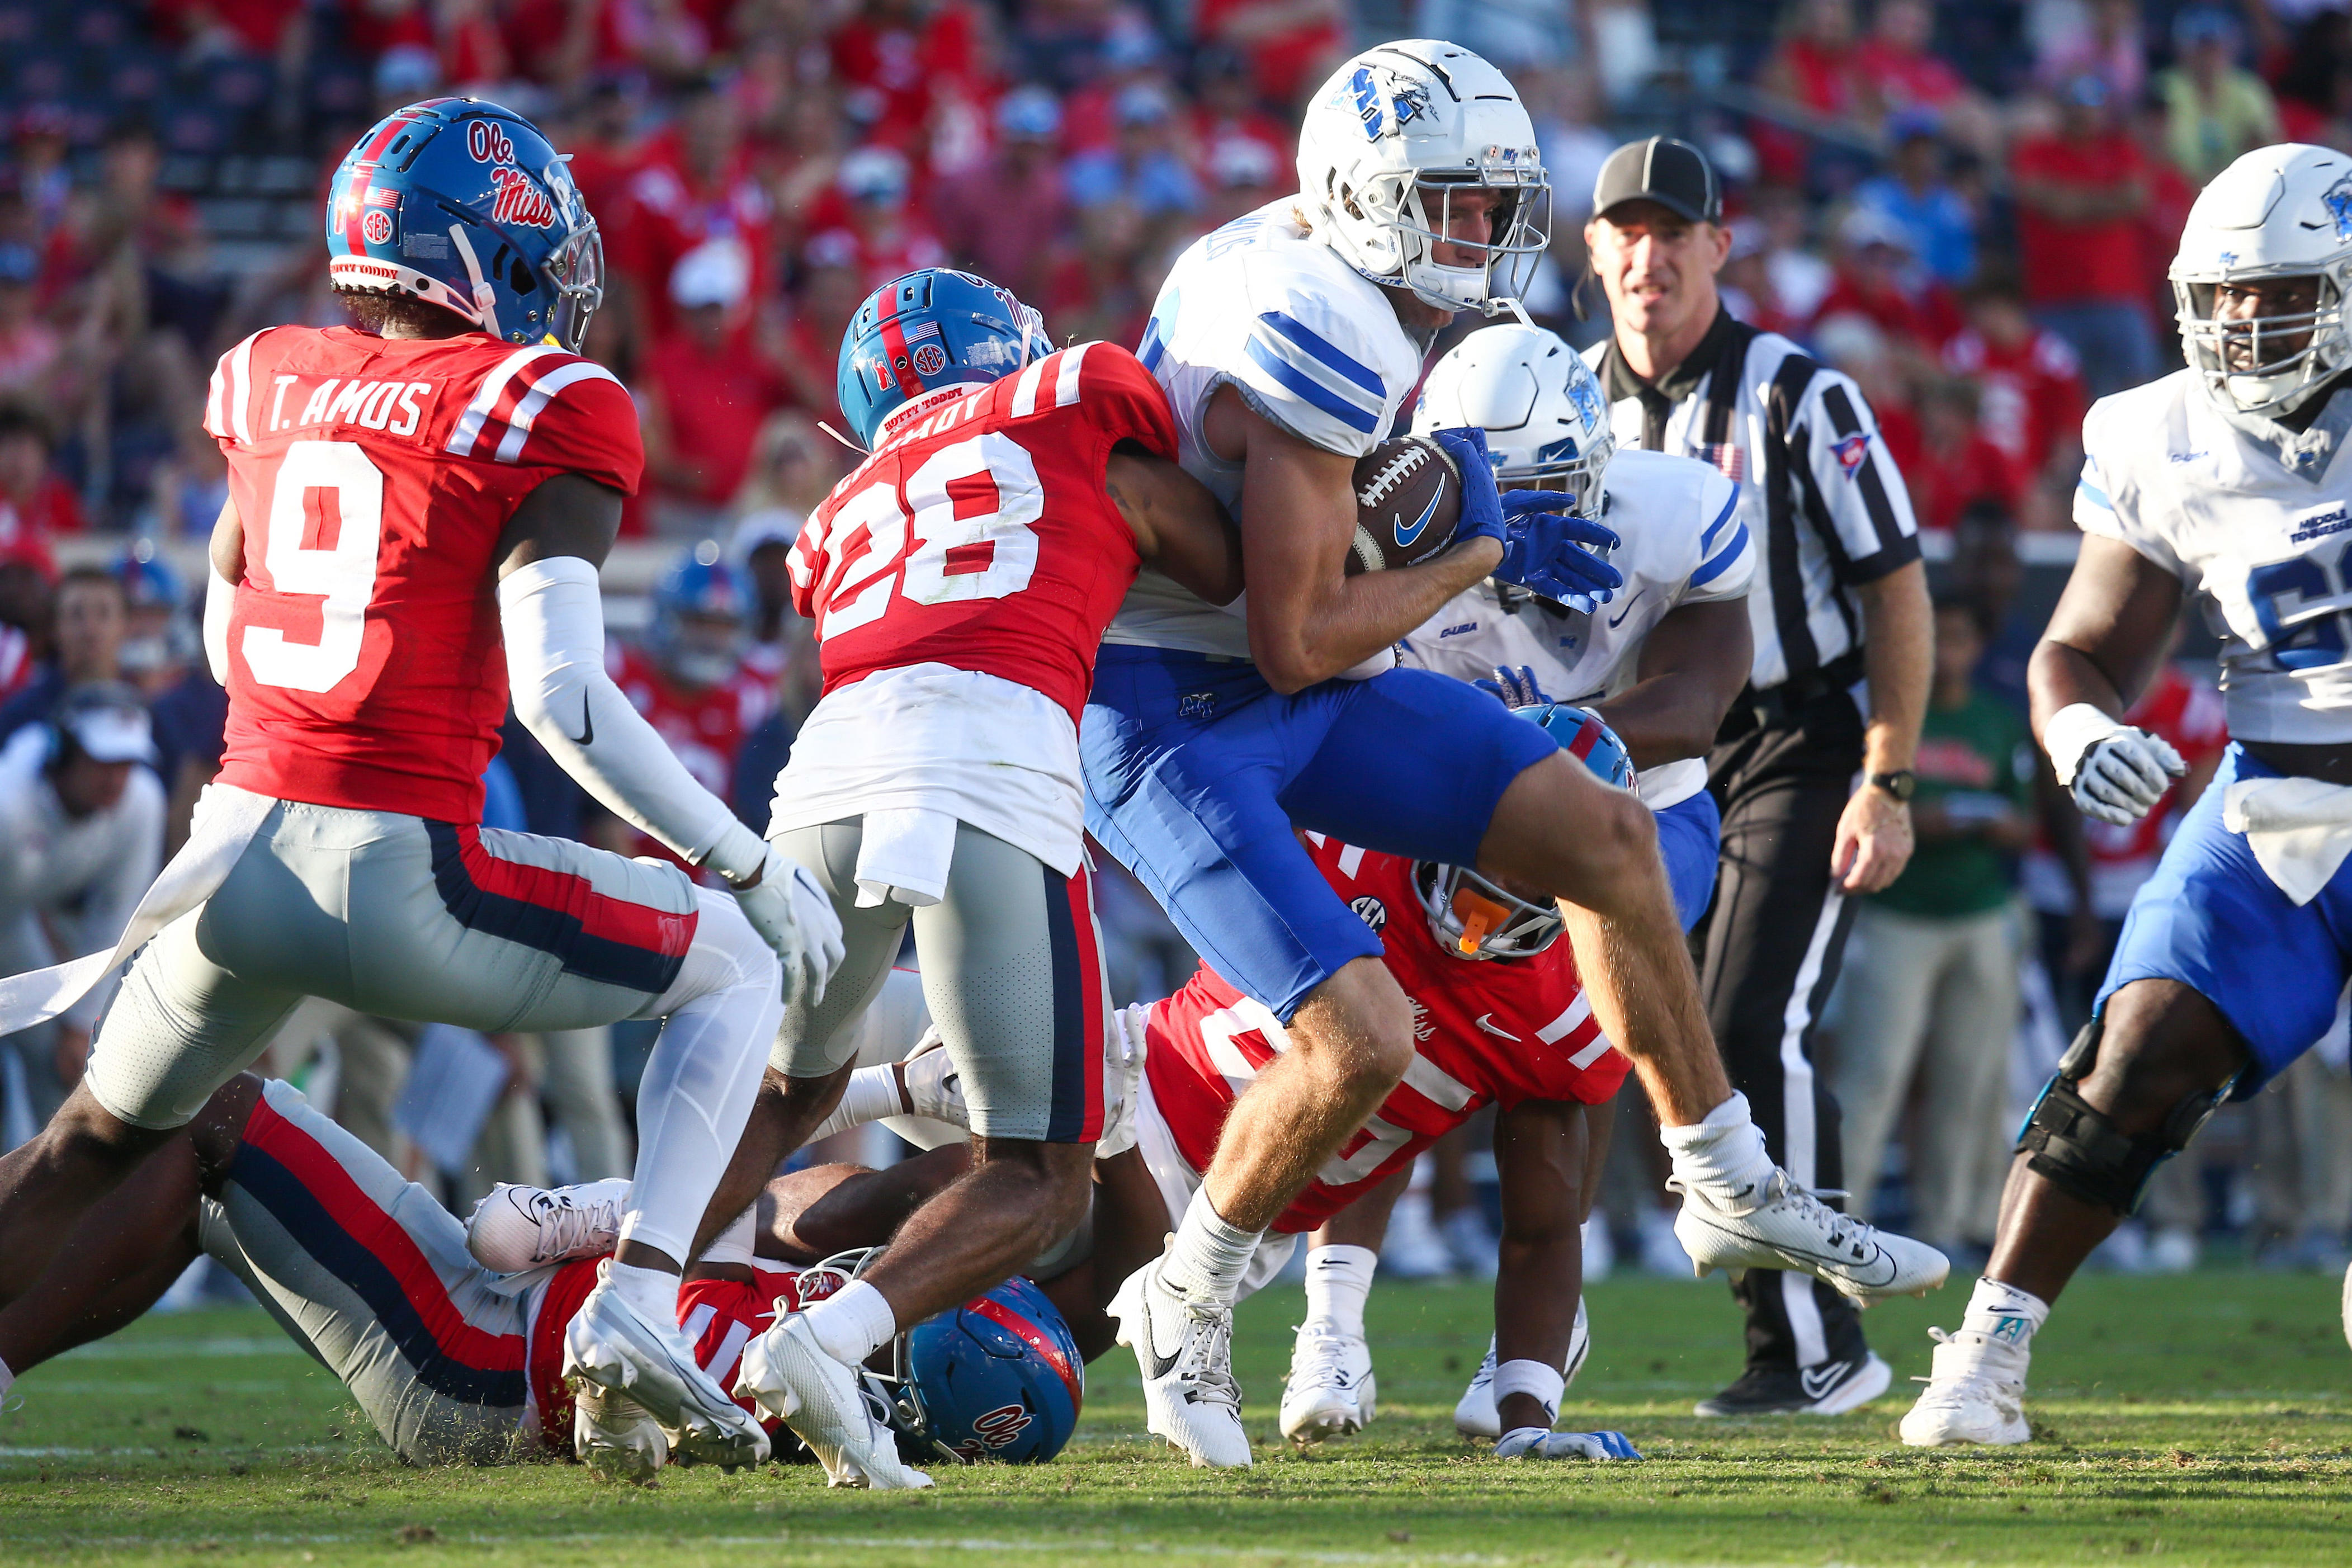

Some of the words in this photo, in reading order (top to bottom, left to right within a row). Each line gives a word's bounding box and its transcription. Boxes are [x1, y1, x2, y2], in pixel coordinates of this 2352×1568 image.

[467, 120, 515, 165] Ole
[490, 167, 556, 230] Miss
[365, 212, 390, 242] SEC
[359, 265, 398, 280] TODDY
[915, 346, 944, 374] SEC
[269, 375, 298, 431] T.
[299, 380, 432, 436] AMOS
[884, 404, 919, 432] HOTTY
[921, 386, 964, 410] TODDY
[820, 431, 1044, 651] 28
[242, 440, 384, 694] 9
[2246, 540, 2352, 672] 6
[1440, 622, 1478, 639] C-USA
[1179, 696, 1215, 719] MT
[972, 1404, 1032, 1449] Ole
